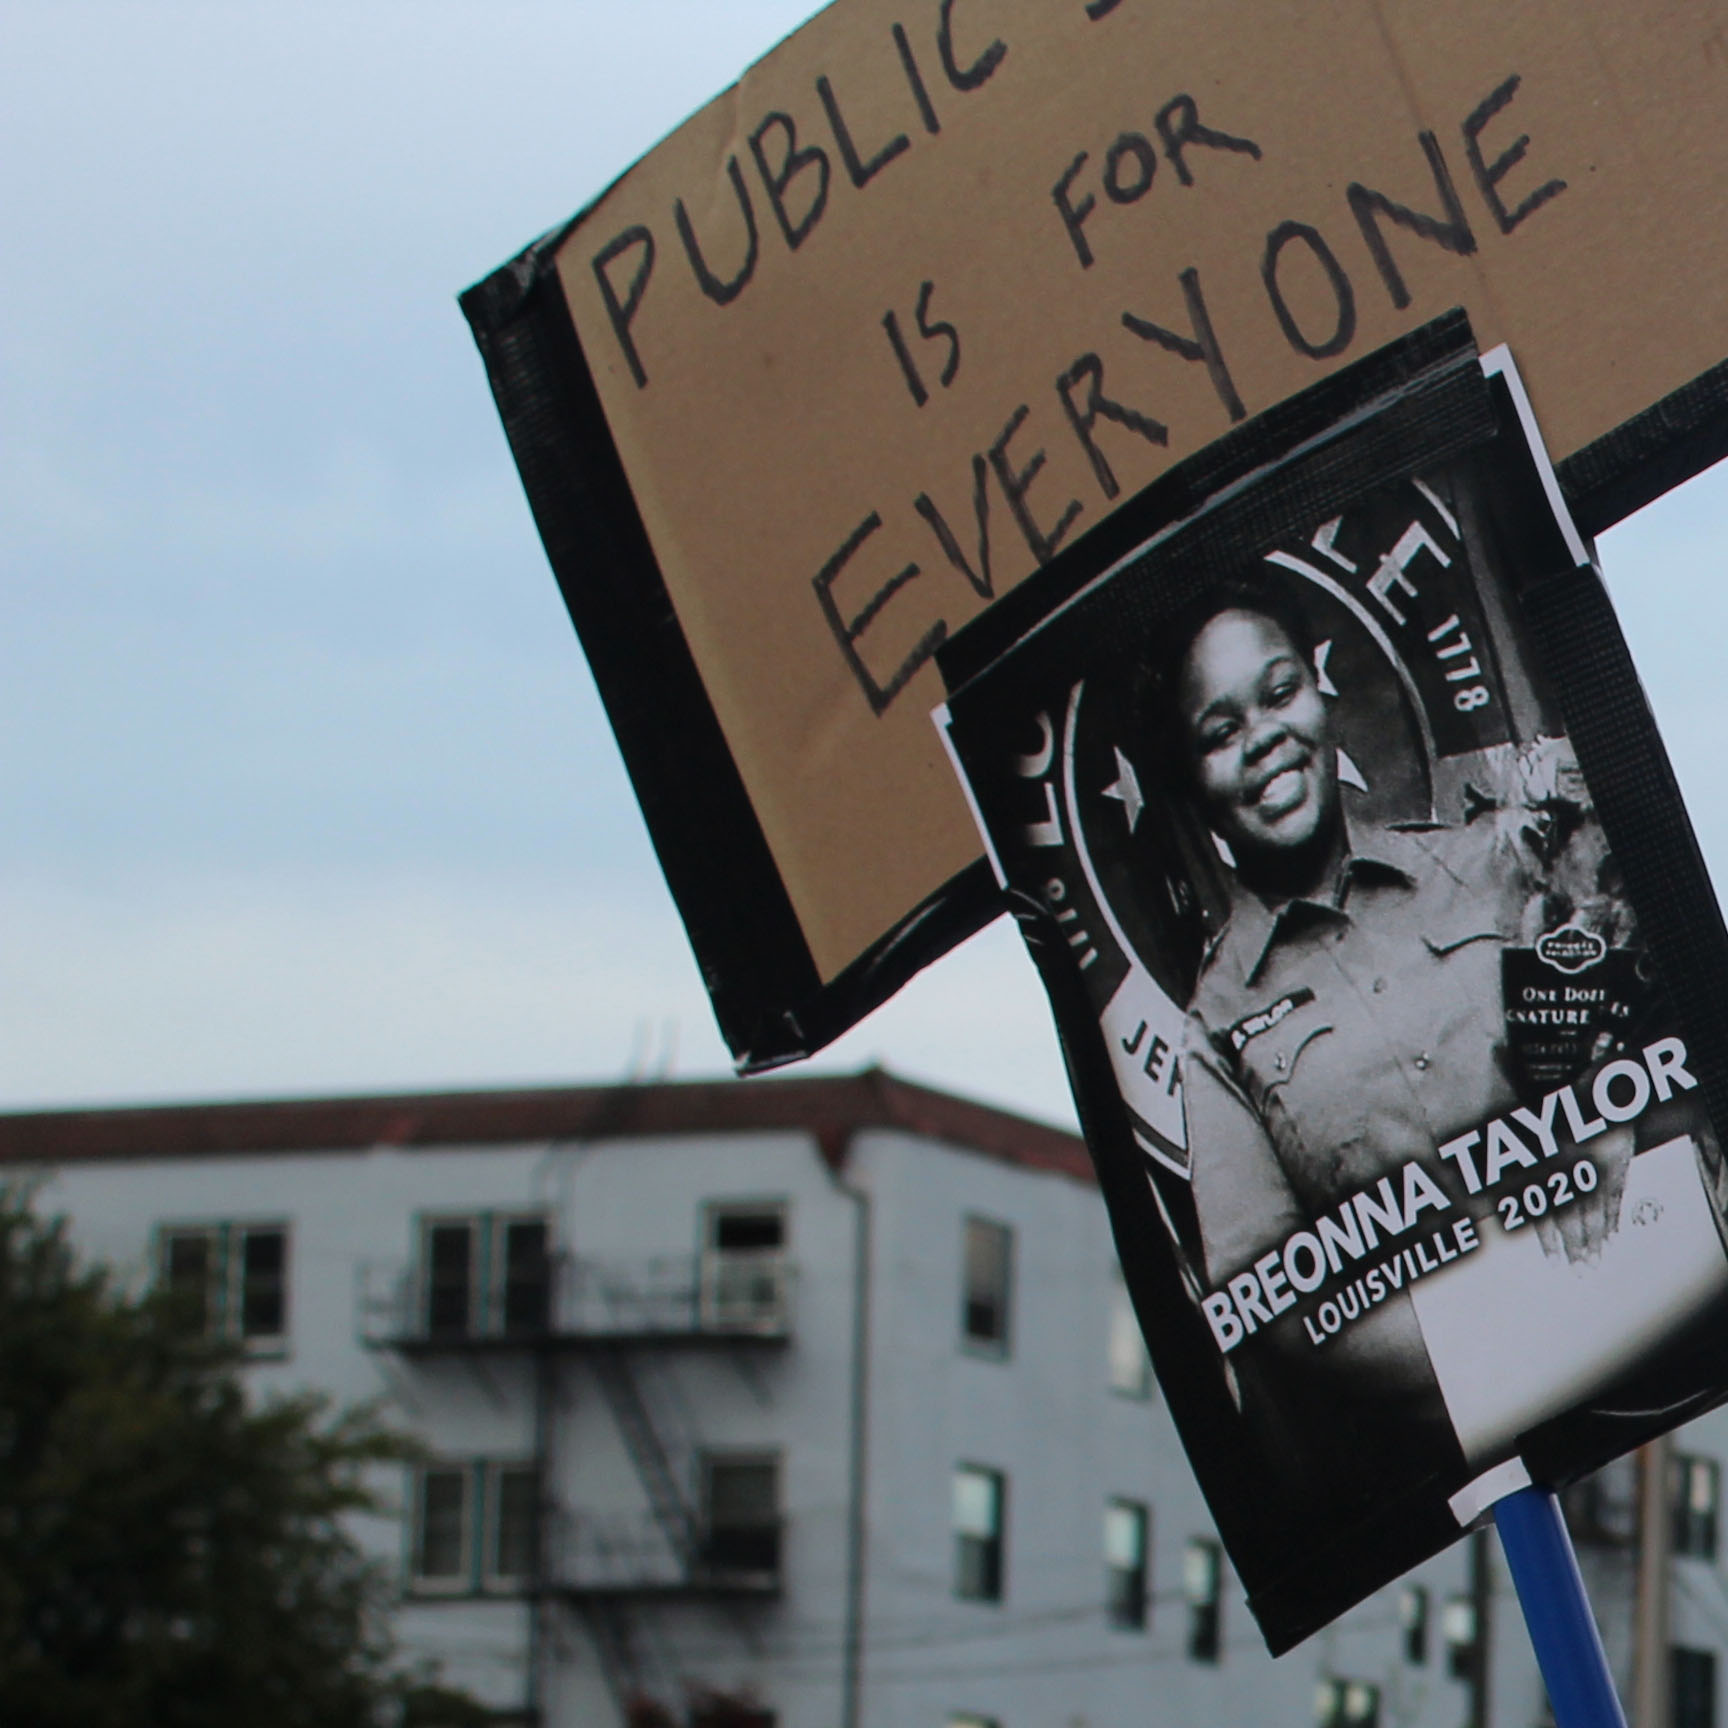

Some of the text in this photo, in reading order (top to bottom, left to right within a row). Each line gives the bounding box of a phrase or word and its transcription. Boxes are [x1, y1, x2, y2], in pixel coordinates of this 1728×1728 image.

[592, 0, 1008, 390] PUBLIC
[881, 94, 1263, 409] IS FOR
[811, 75, 1568, 718] EVERYONE
[1427, 613, 1490, 712] 1778
[1201, 1036, 1698, 1353] BREONNA TAYLOR
[1303, 1159, 1598, 1345] LOUISVILLE 2020
